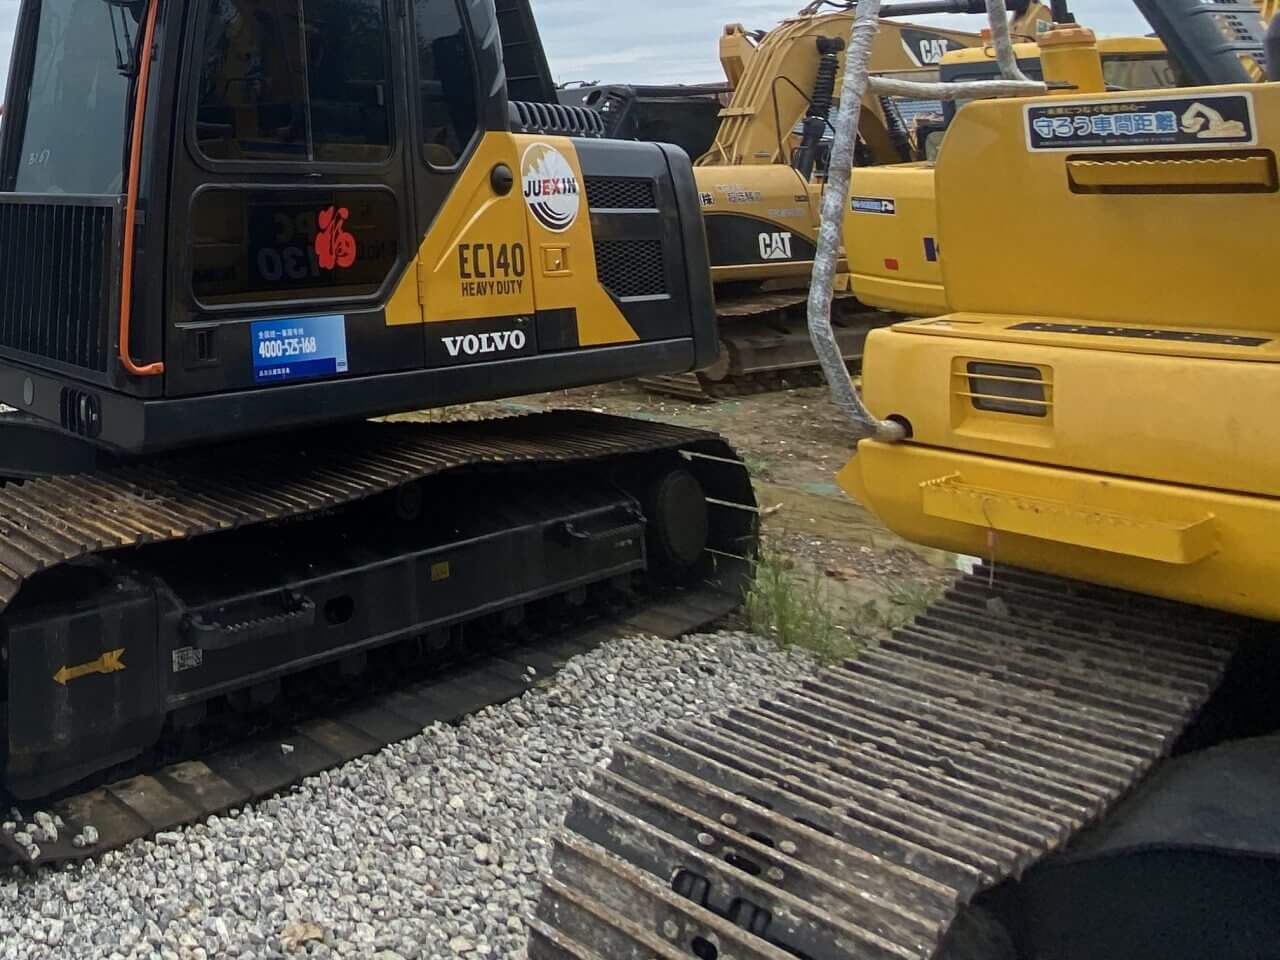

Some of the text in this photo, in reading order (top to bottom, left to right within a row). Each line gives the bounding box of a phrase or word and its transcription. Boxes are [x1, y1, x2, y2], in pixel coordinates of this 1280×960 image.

[920, 39, 948, 63] CAT
[524, 177, 577, 198] JUEXIN
[758, 232, 792, 259] CAT
[458, 242, 525, 279] EC140
[462, 279, 522, 297] HEAVY DUTY
[441, 329, 526, 356] VOLVO
